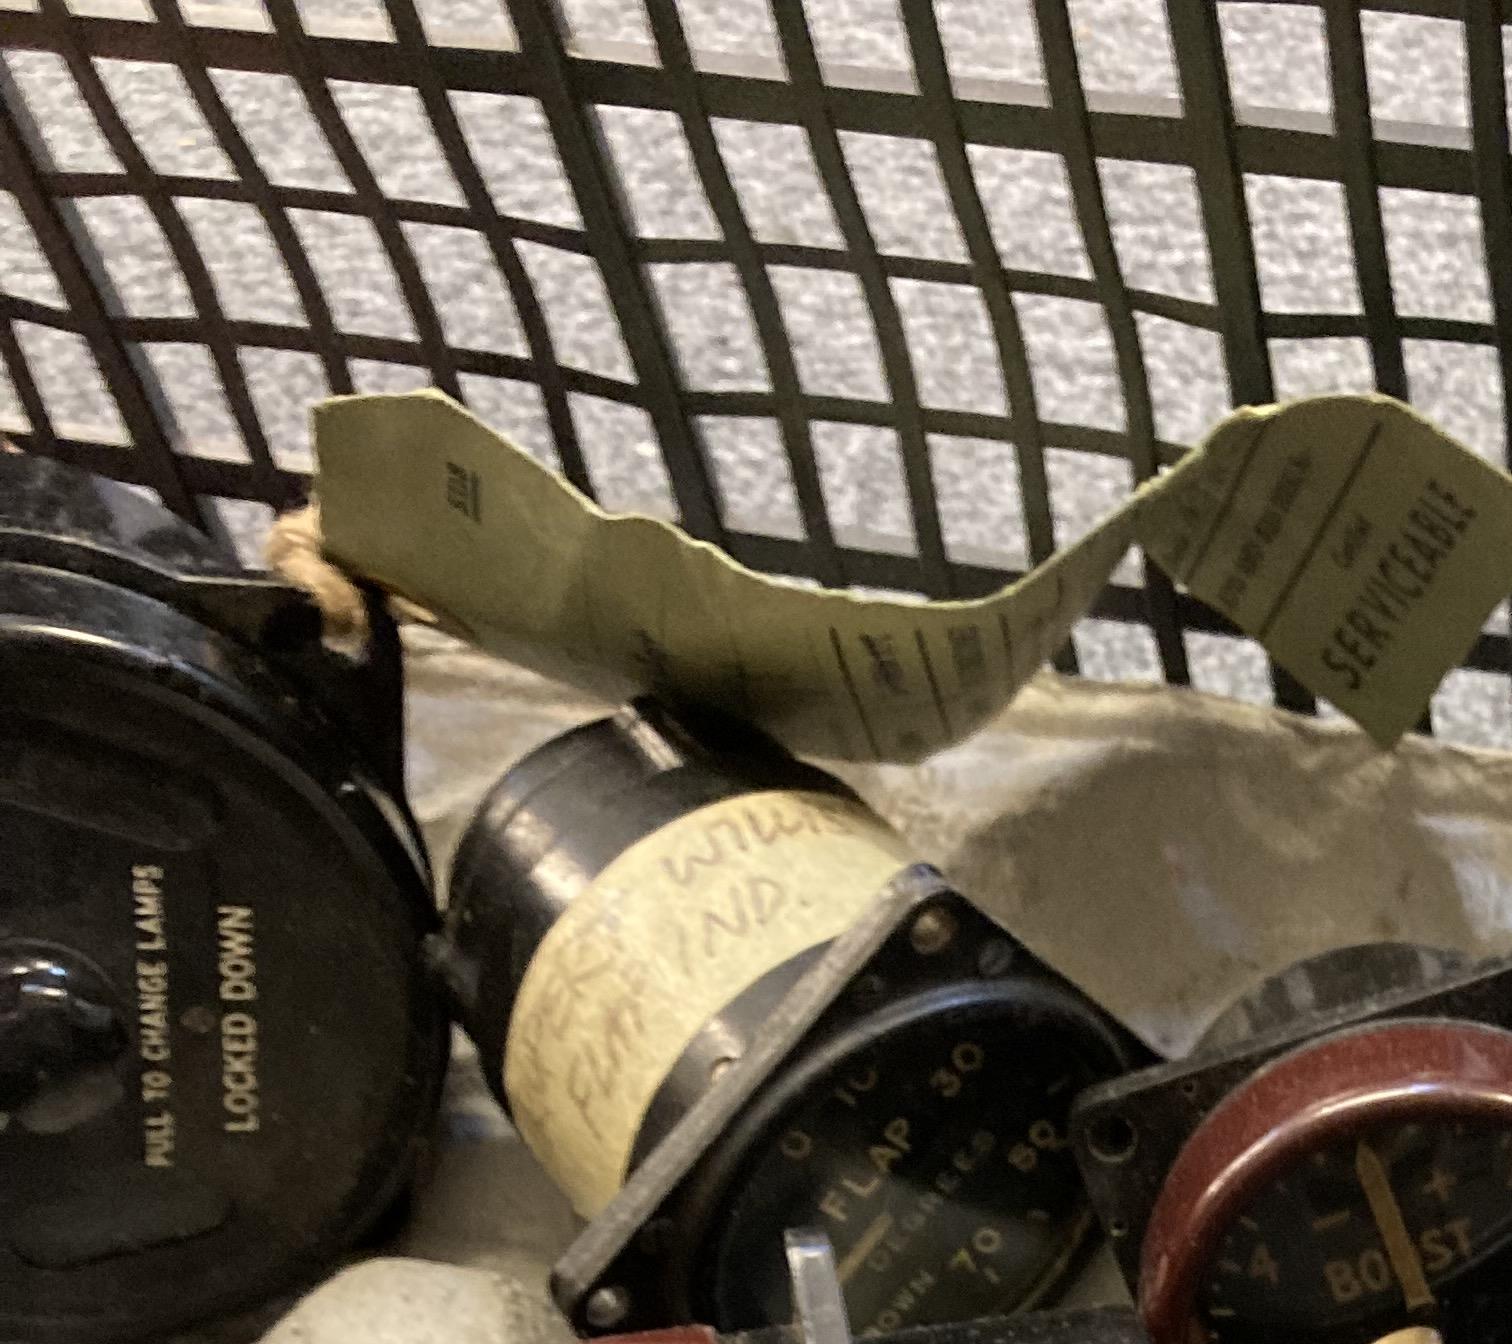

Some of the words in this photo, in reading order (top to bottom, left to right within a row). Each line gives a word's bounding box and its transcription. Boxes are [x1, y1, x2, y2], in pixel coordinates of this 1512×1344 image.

[1321, 477, 1478, 690] SERVICEABLE
[131, 864, 168, 951] LAMPS
[216, 904, 258, 1002] DOWN
[135, 960, 171, 1061] CHANGE
[141, 1070, 173, 1102] TO
[220, 1012, 260, 1132] LOCKED
[930, 1041, 985, 1098] 30
[144, 1109, 176, 1168] PULL
[817, 1117, 913, 1222] FLAP
[1323, 1215, 1475, 1303] BOST
